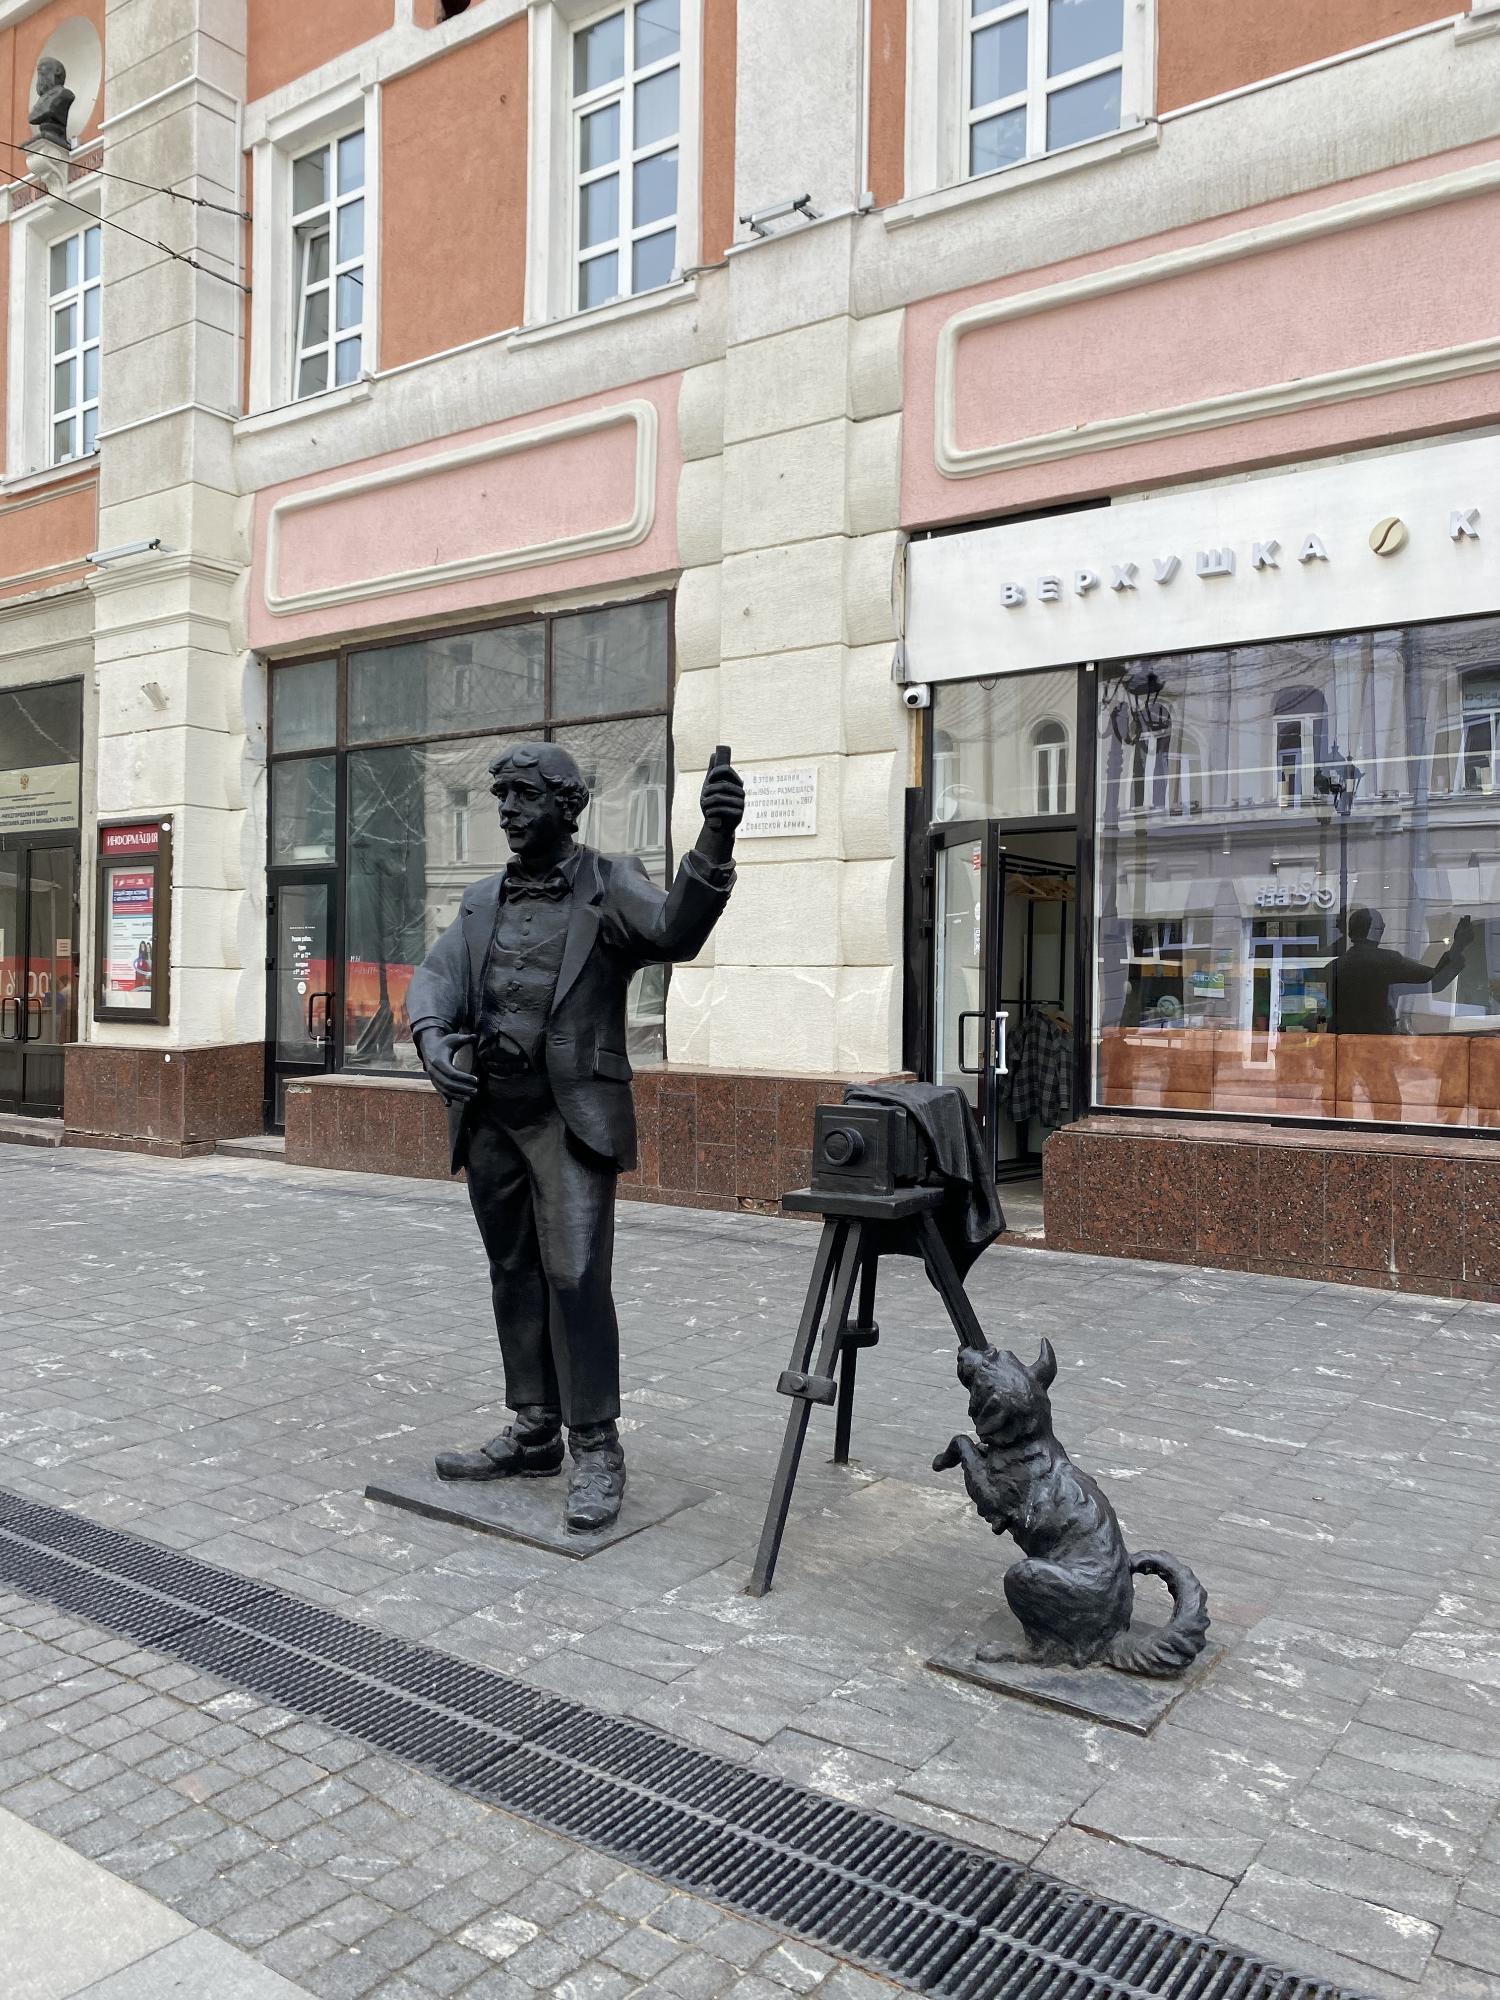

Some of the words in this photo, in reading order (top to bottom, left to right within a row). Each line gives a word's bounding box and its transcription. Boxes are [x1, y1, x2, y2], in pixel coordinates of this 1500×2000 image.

[999, 533, 1330, 609] ВЕРХУШКА
[1448, 507, 1481, 542] К
[106, 831, 159, 847] ИНФОРМАЦИЯ
